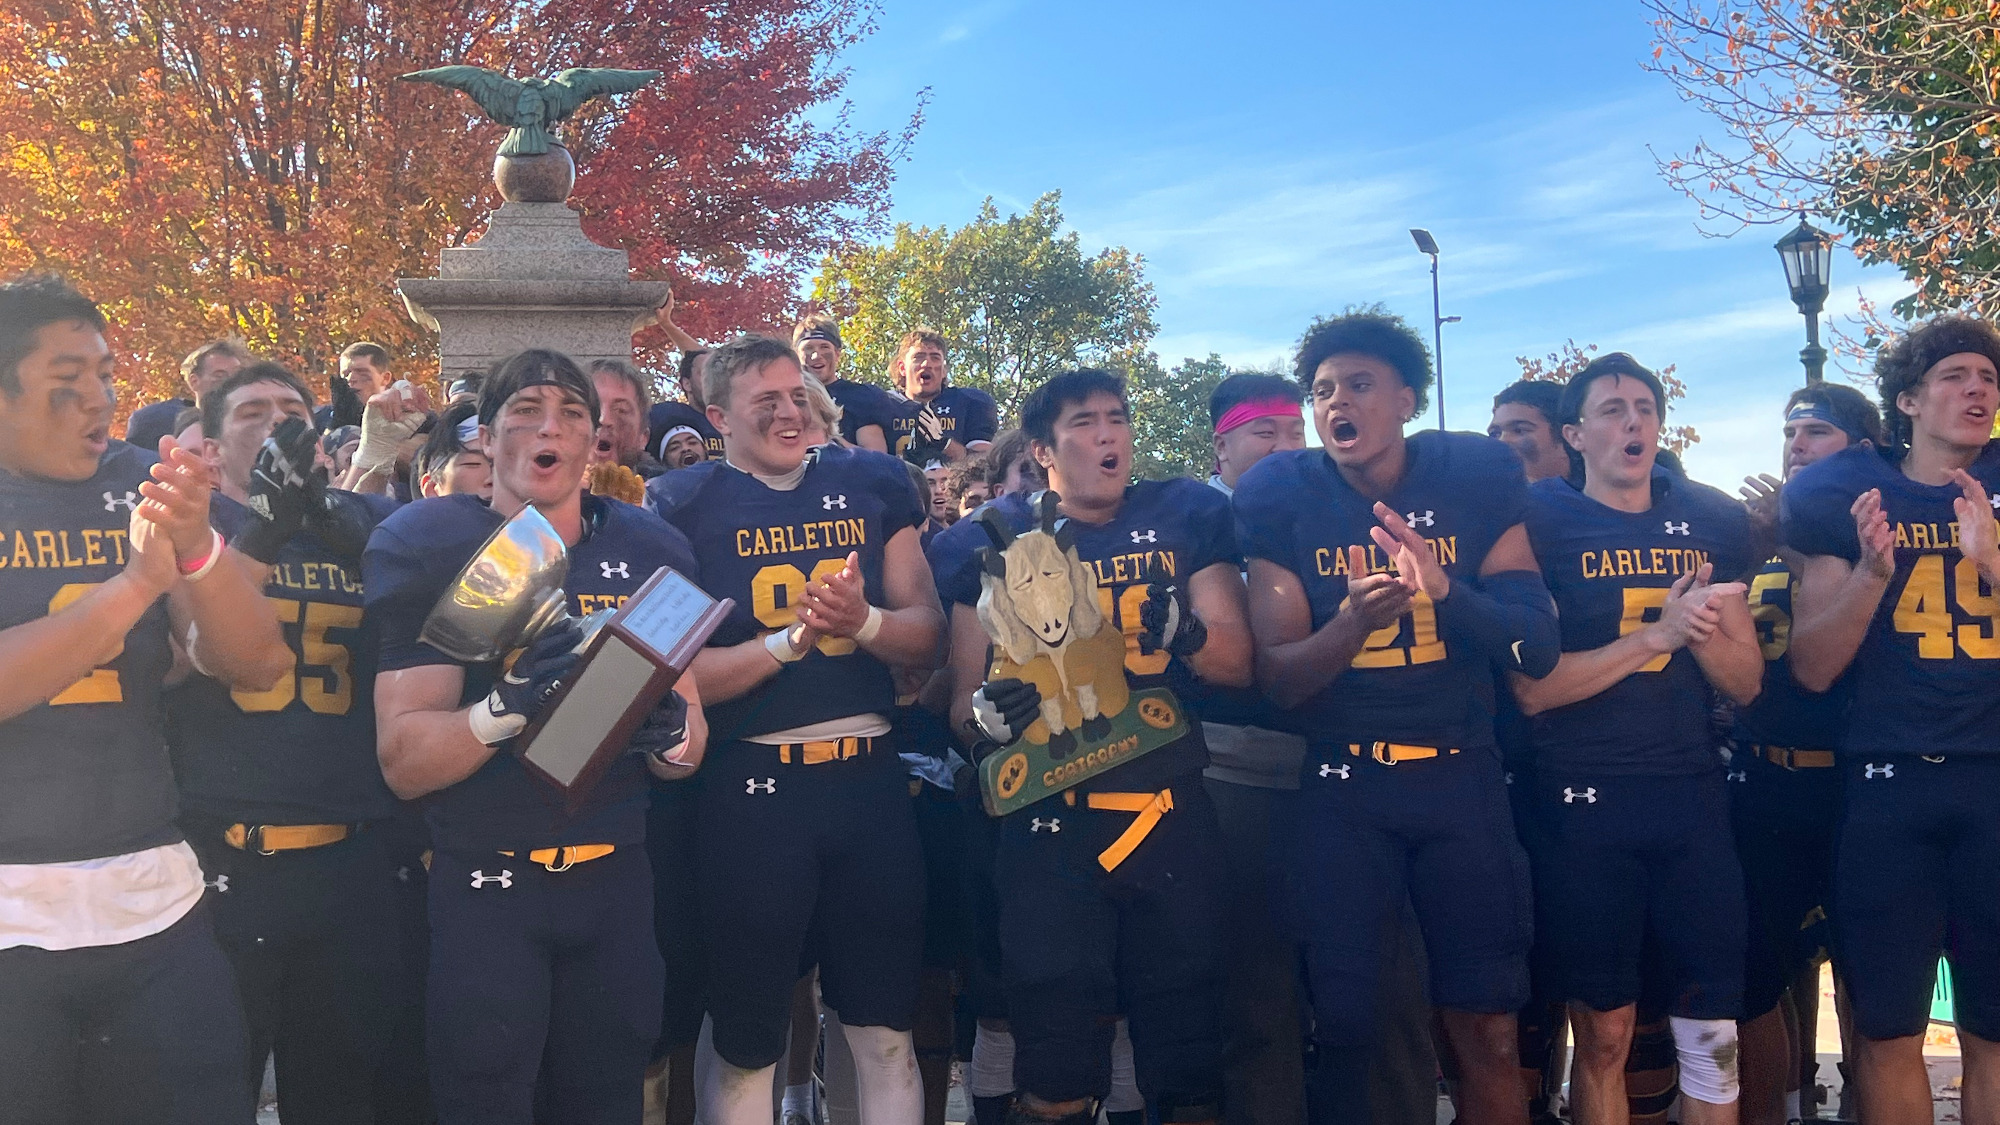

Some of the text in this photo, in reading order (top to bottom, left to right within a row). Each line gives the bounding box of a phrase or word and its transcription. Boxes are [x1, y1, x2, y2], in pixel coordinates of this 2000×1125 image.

[893, 417, 957, 431] CARON
[0, 529, 127, 568] ARLET
[736, 518, 866, 557] CARLETON
[1894, 521, 1960, 549] ARLE
[1892, 554, 2000, 660] 49
